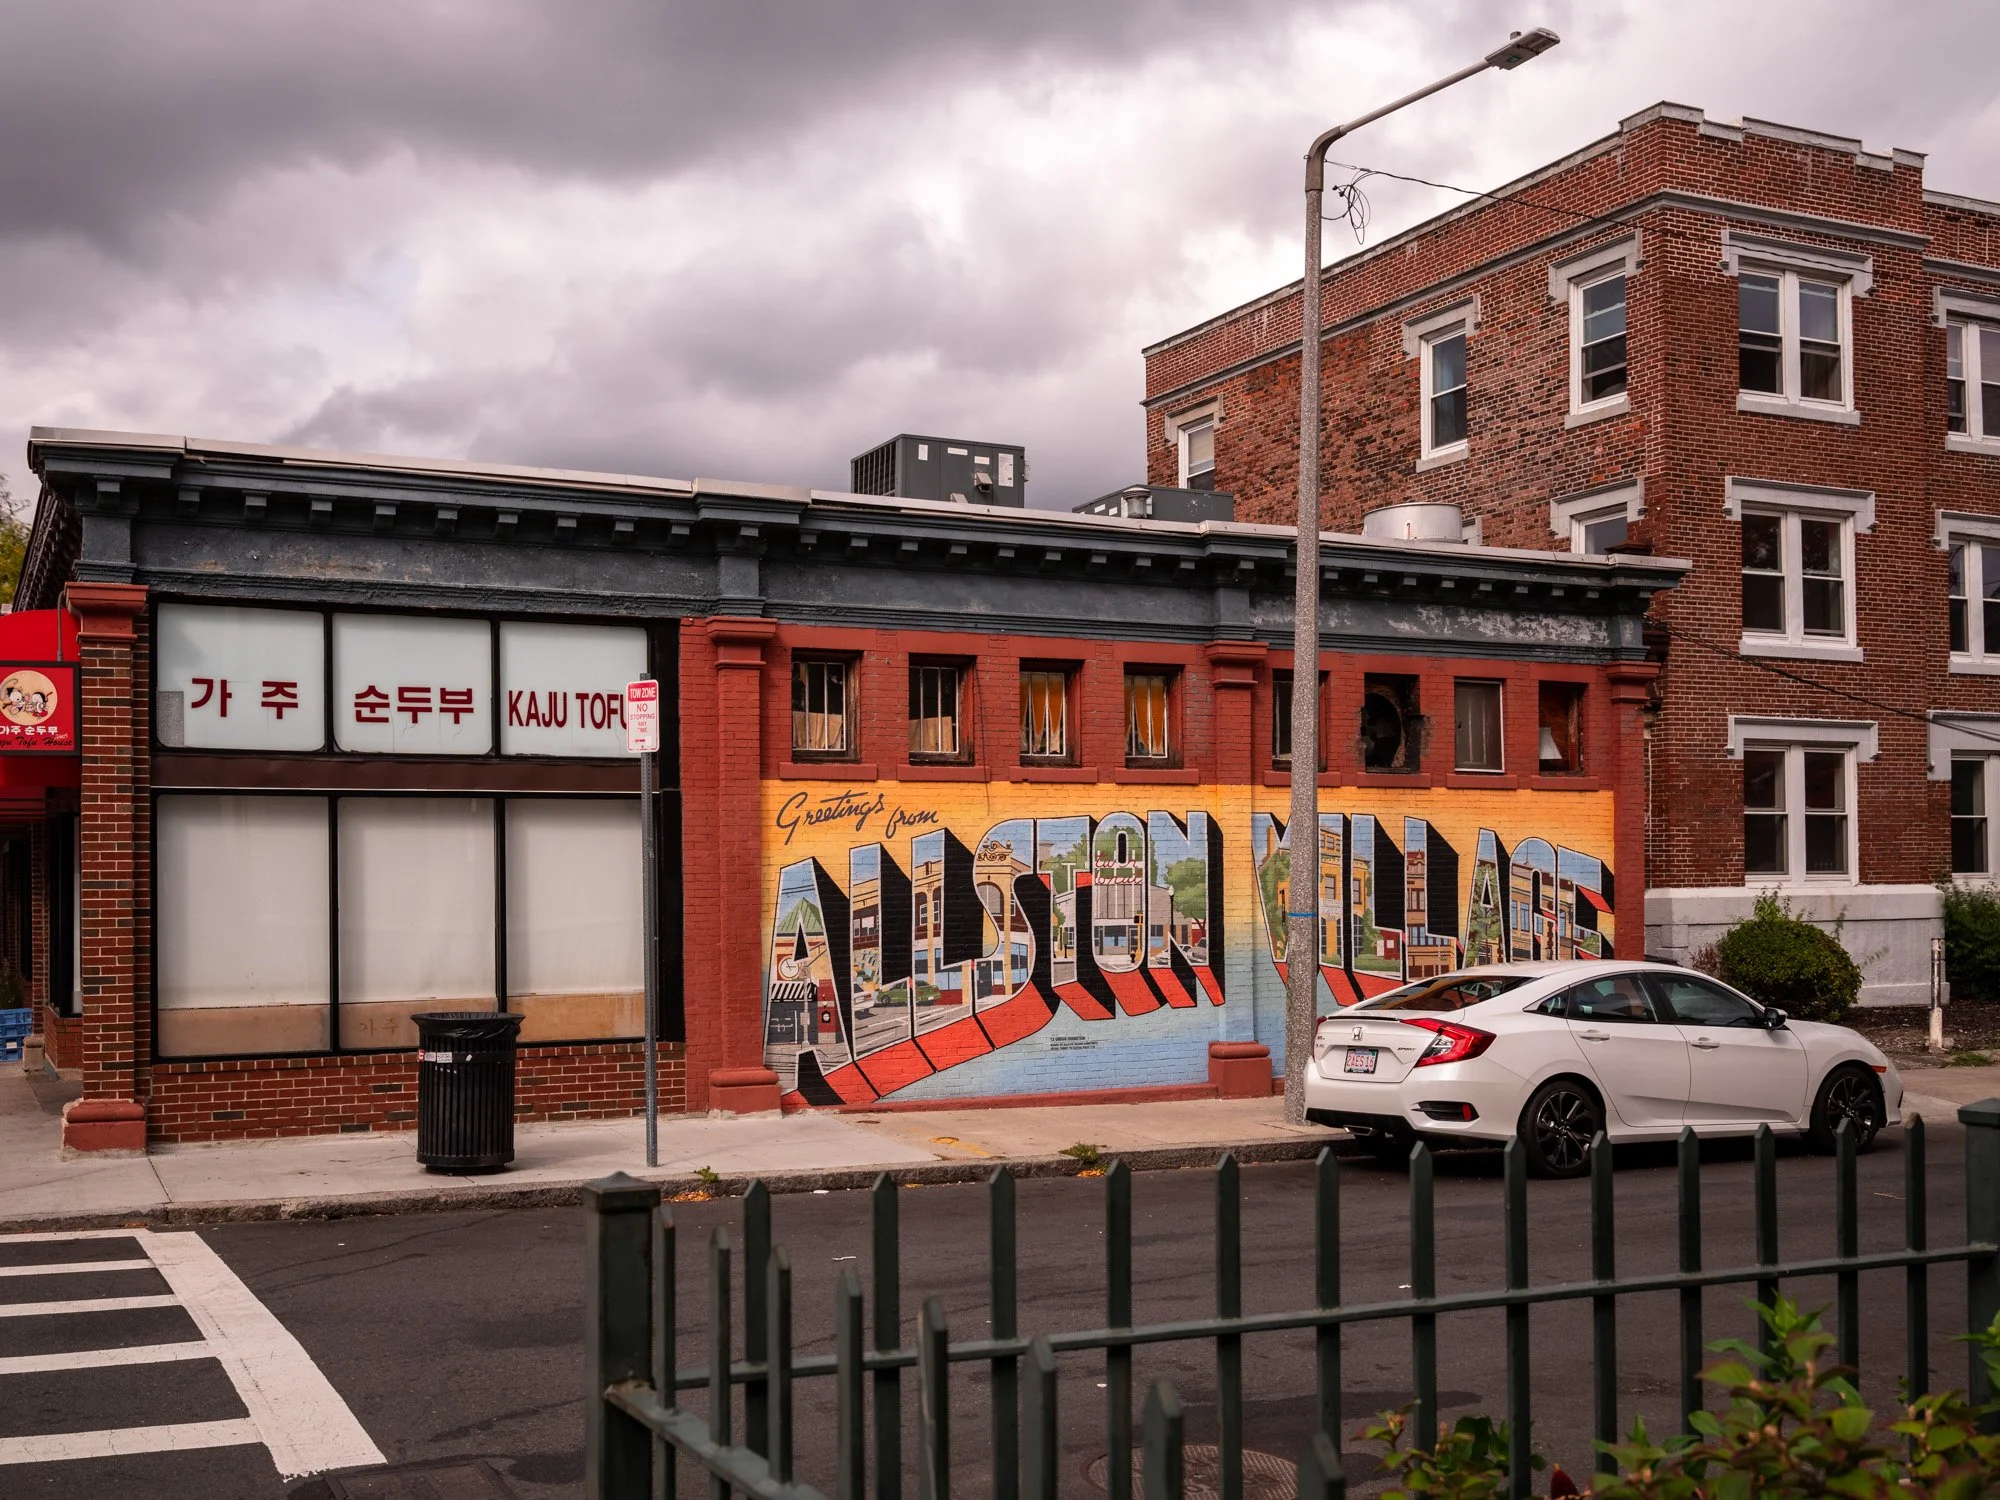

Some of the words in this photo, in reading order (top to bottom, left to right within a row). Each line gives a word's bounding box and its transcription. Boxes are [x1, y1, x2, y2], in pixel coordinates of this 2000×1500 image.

[354, 685, 474, 725] 순두부
[630, 688, 641, 699] TOW
[641, 687, 656, 698] ZONE
[508, 690, 568, 728] KAJU
[636, 703, 648, 712] NO
[15, 736, 37, 748] Tofu
[43, 737, 72, 746] House
[25, 725, 58, 736] 순두부
[776, 790, 885, 845] Greetings
[885, 805, 939, 839] from
[763, 811, 1224, 1104] ALLSTON
